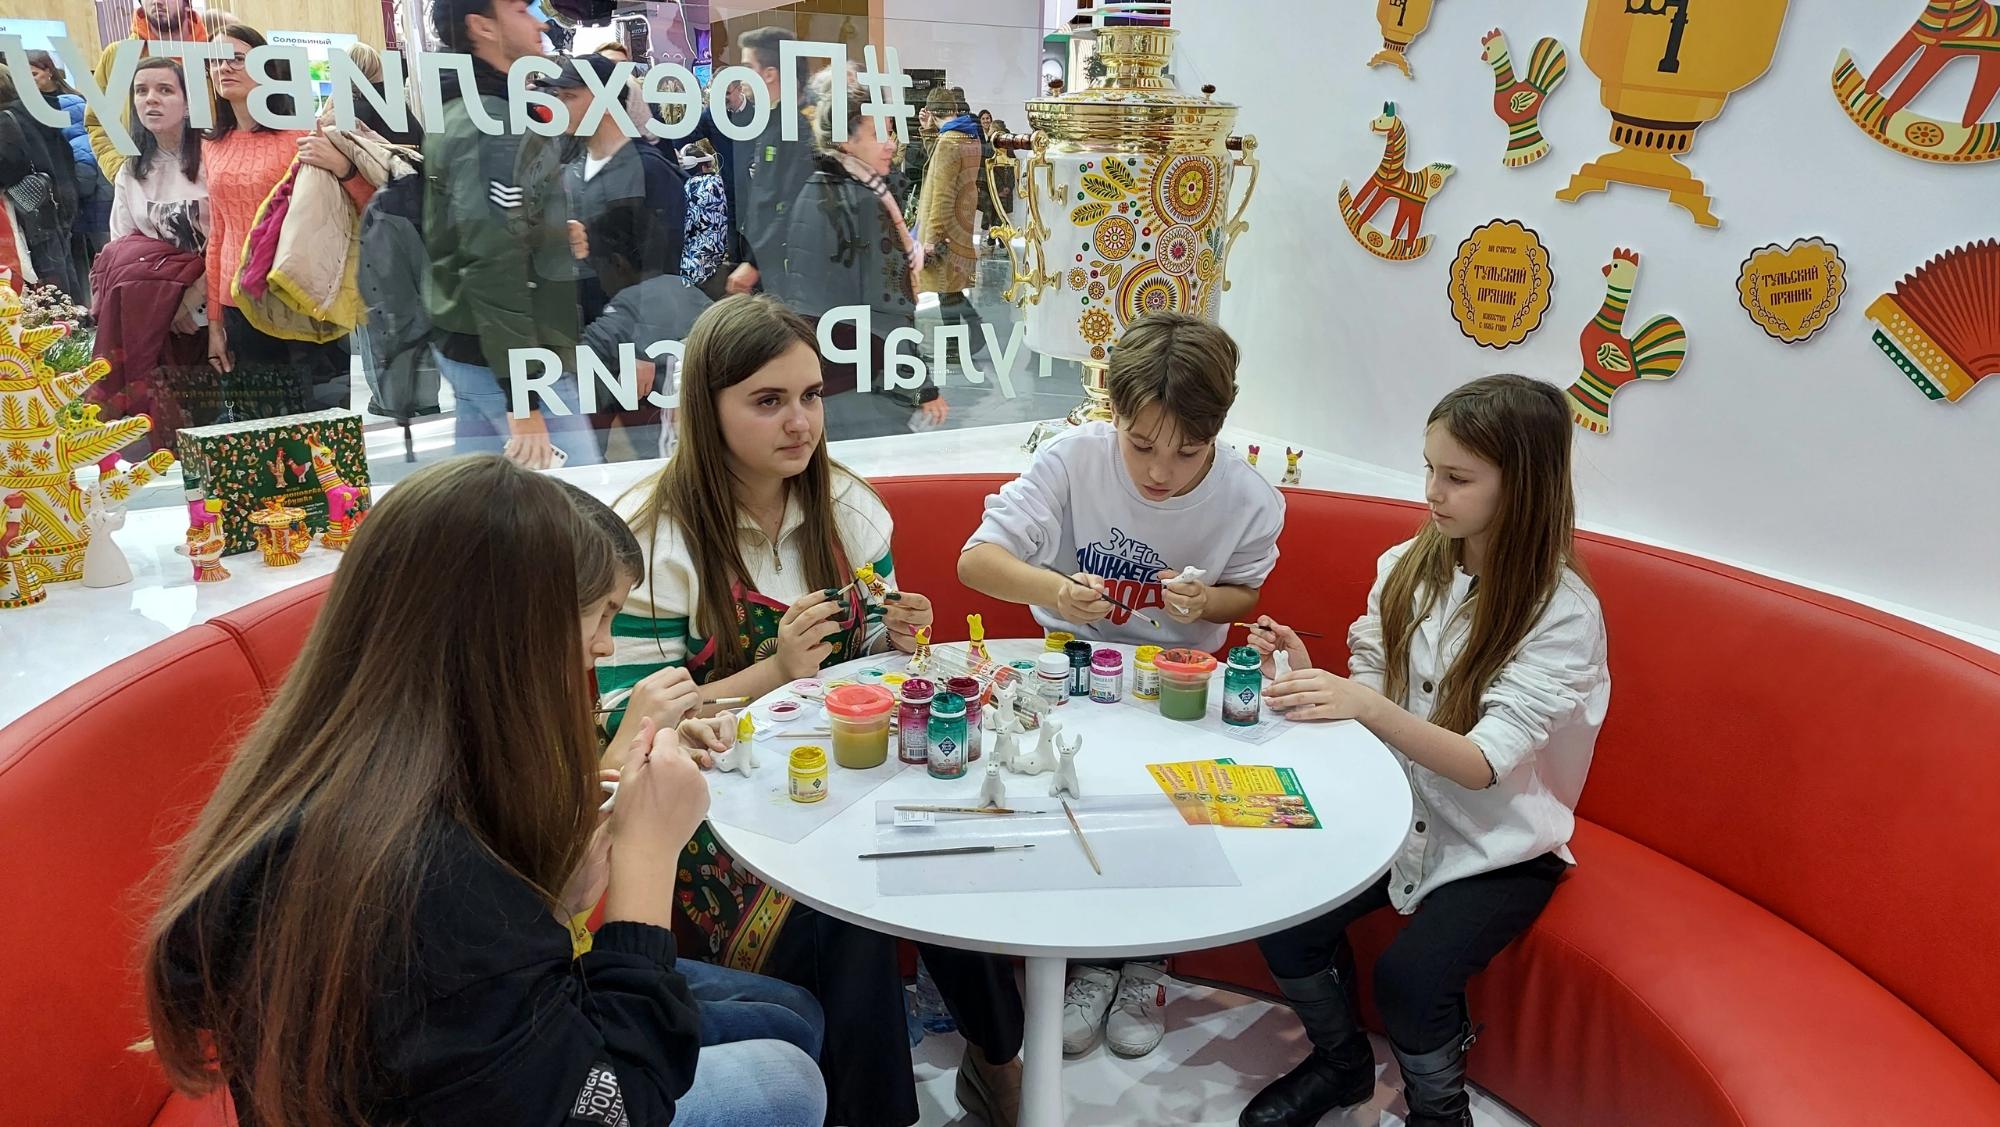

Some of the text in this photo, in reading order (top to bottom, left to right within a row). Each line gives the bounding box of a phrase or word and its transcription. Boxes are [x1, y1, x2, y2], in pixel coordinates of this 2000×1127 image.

[1474, 265, 1527, 284] ТУЛЬСКИЙ
[1761, 265, 1819, 288] ТУЛЬСКИЙ
[1477, 287, 1517, 306] ПРЯНИК
[1770, 287, 1812, 306] ПРЯНИК
[577, 1067, 601, 1114] DESIGN
[586, 1071, 618, 1116] YOUR
